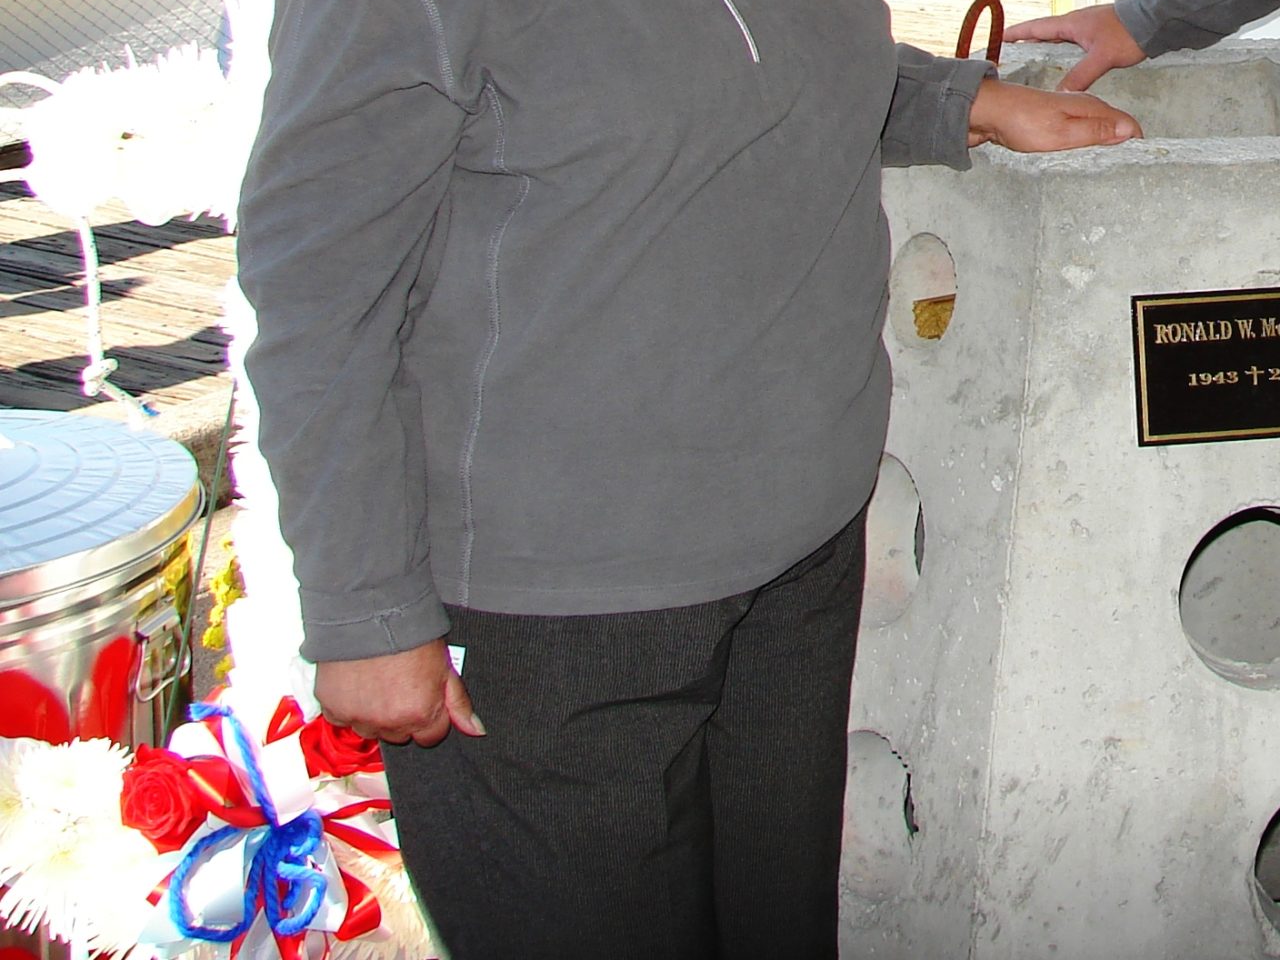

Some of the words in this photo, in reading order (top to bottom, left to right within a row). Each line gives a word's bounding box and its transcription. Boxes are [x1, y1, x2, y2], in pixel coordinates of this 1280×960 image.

[1153, 319, 1232, 344] RONALD
[1235, 318, 1256, 339] W.
[1188, 371, 1239, 386] 1943
